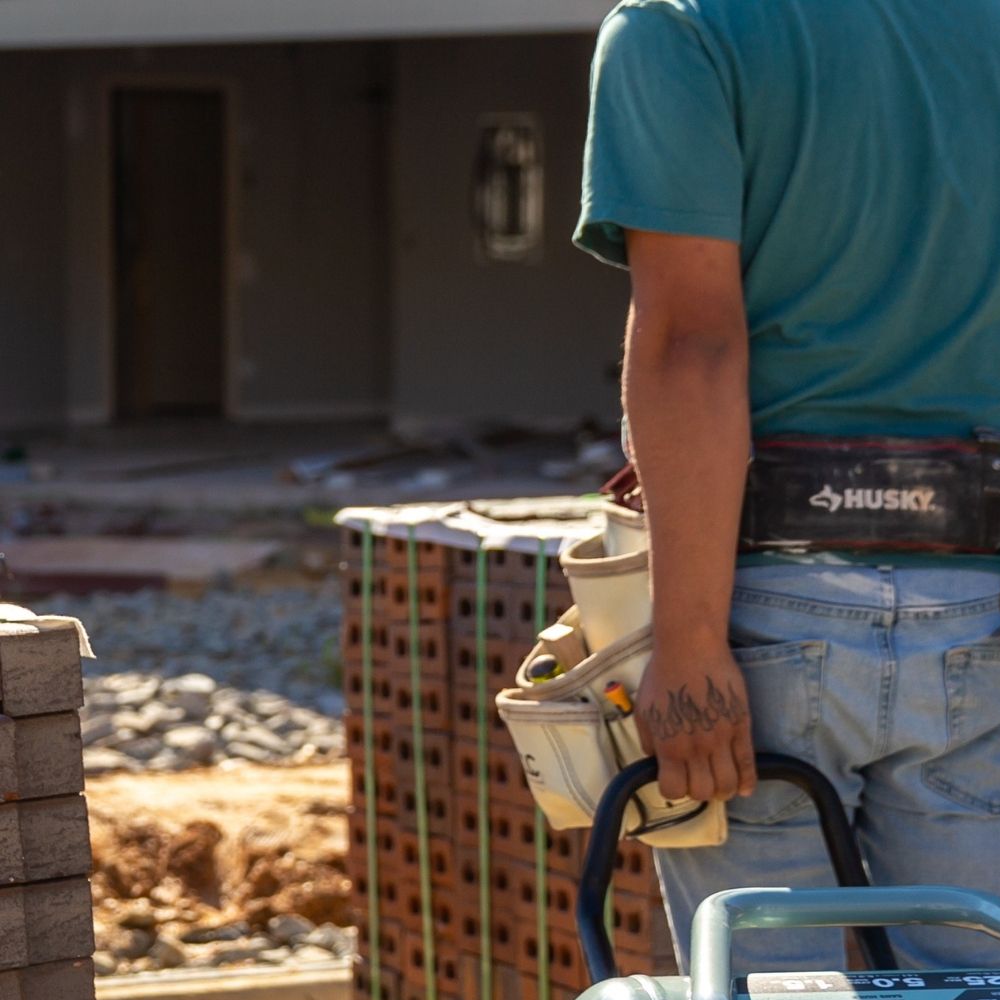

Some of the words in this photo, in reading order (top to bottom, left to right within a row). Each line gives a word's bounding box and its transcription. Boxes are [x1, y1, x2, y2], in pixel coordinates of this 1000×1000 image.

[844, 488, 935, 511] HUSKY
[781, 978, 834, 990] 1.5
[871, 977, 926, 988] 5.0
